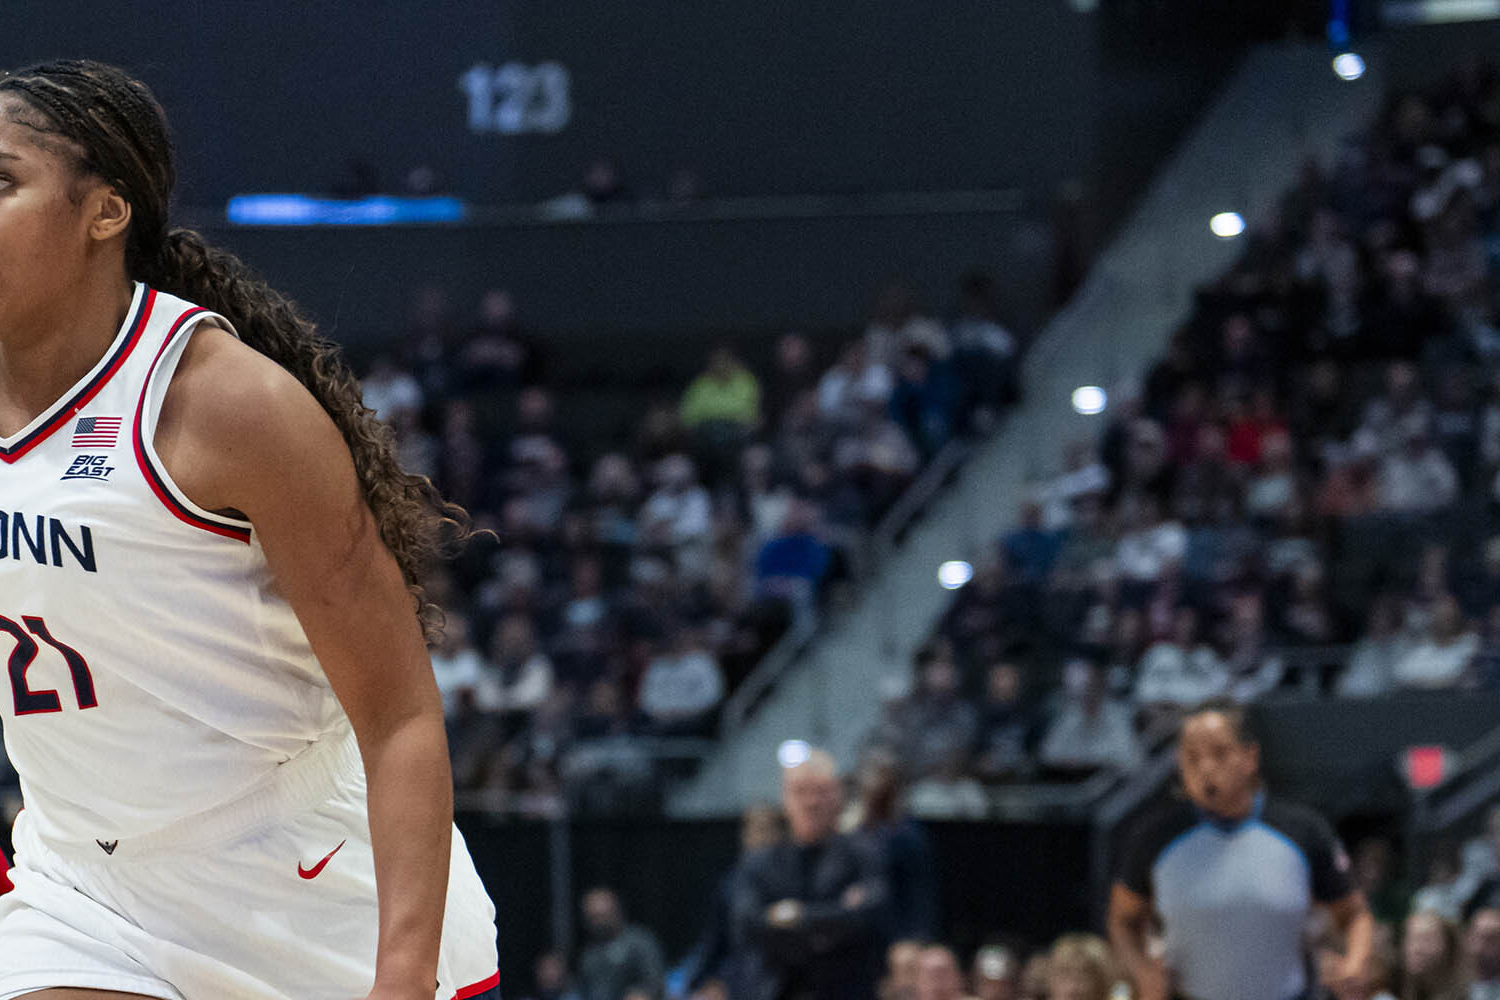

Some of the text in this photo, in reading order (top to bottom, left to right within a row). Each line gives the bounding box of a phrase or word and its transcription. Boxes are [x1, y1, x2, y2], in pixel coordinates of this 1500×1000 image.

[460, 62, 569, 134] 123
[73, 454, 108, 466] BIG
[65, 465, 116, 477] EAST
